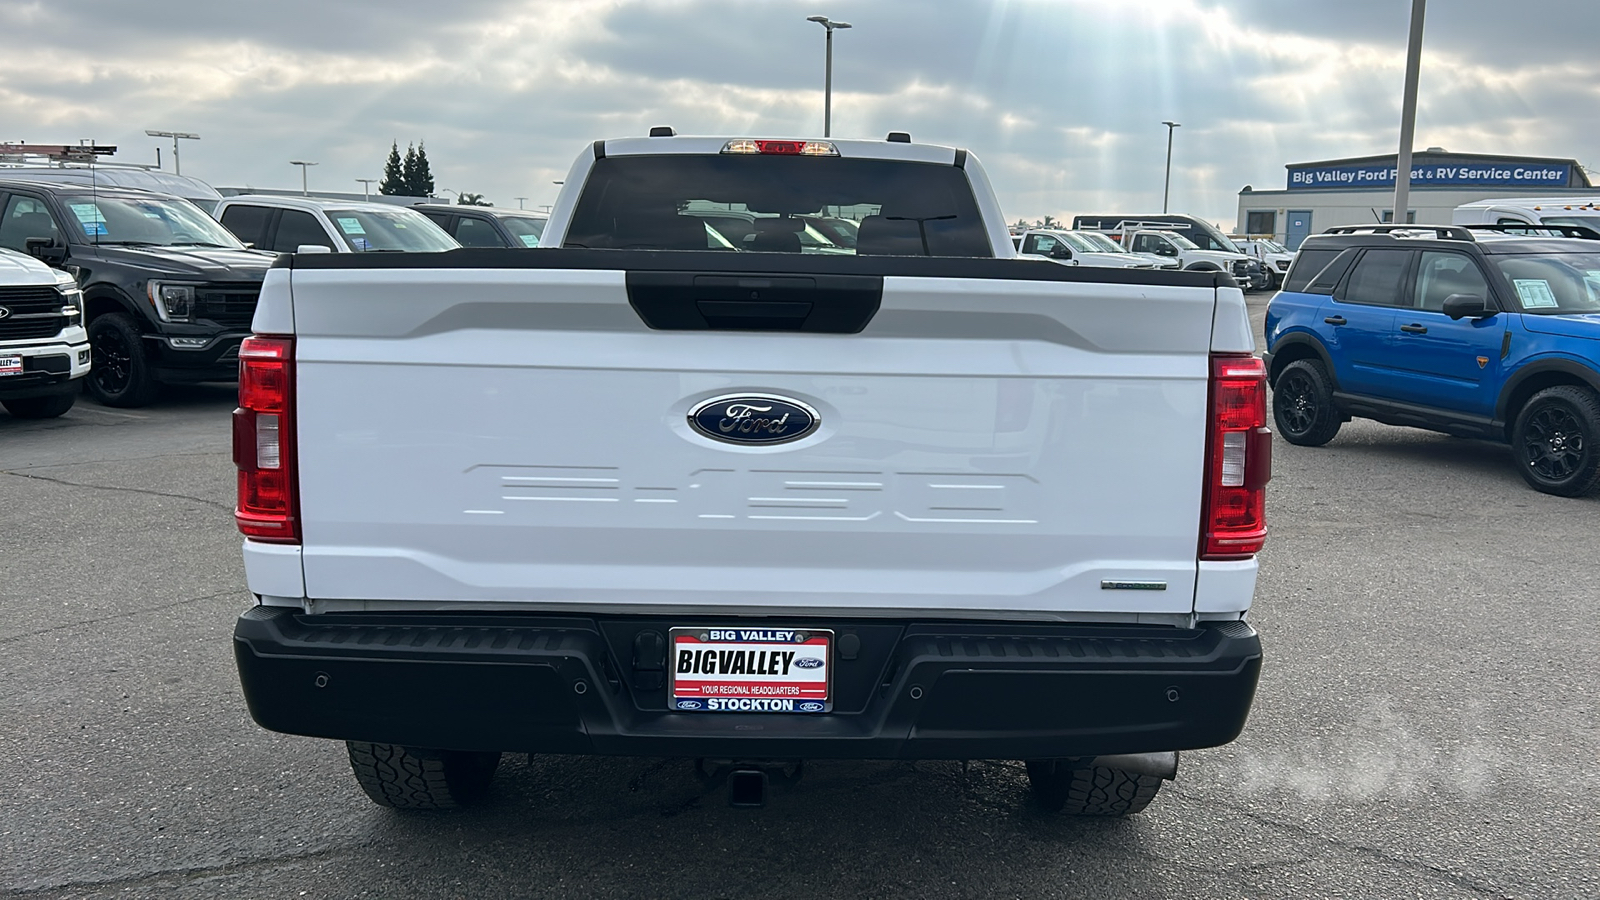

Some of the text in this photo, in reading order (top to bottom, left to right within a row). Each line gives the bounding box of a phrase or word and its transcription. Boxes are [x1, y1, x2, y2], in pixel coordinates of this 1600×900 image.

[1293, 168, 1563, 184] Big Valley Ford Fet & RV Service Center
[719, 404, 790, 434] Ford
[462, 464, 1040, 524] F-150
[710, 630, 794, 641] BIG VALLEY
[677, 649, 796, 676] BIGVALLEY
[701, 685, 800, 695] YOUR REGIONAL HEADQUARTERS
[708, 698, 794, 711] STOCKTON
